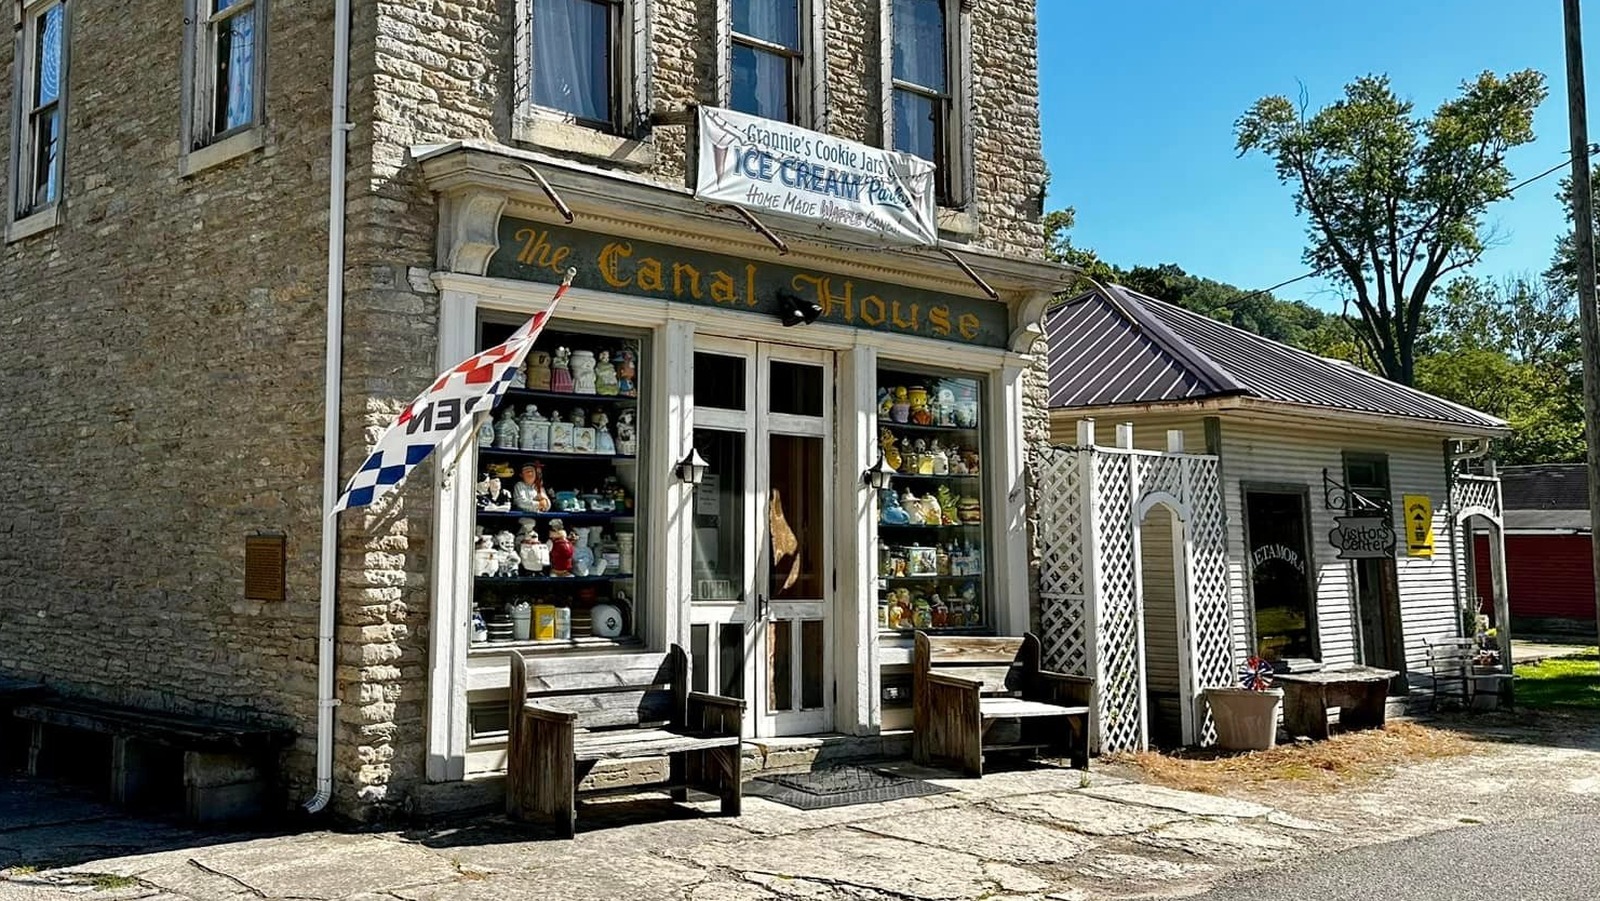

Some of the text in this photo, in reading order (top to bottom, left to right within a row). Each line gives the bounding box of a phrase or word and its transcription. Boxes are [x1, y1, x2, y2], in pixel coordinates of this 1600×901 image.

[733, 145, 772, 183] ICE
[780, 156, 861, 203] CREAM
[747, 123, 812, 157] Grannie's
[815, 140, 857, 168] Cookie
[860, 152, 884, 175] Jars
[746, 184, 781, 208] HOME
[783, 191, 817, 216] MADE
[514, 227, 981, 341] The Canal House
[701, 580, 729, 599] OPEN
